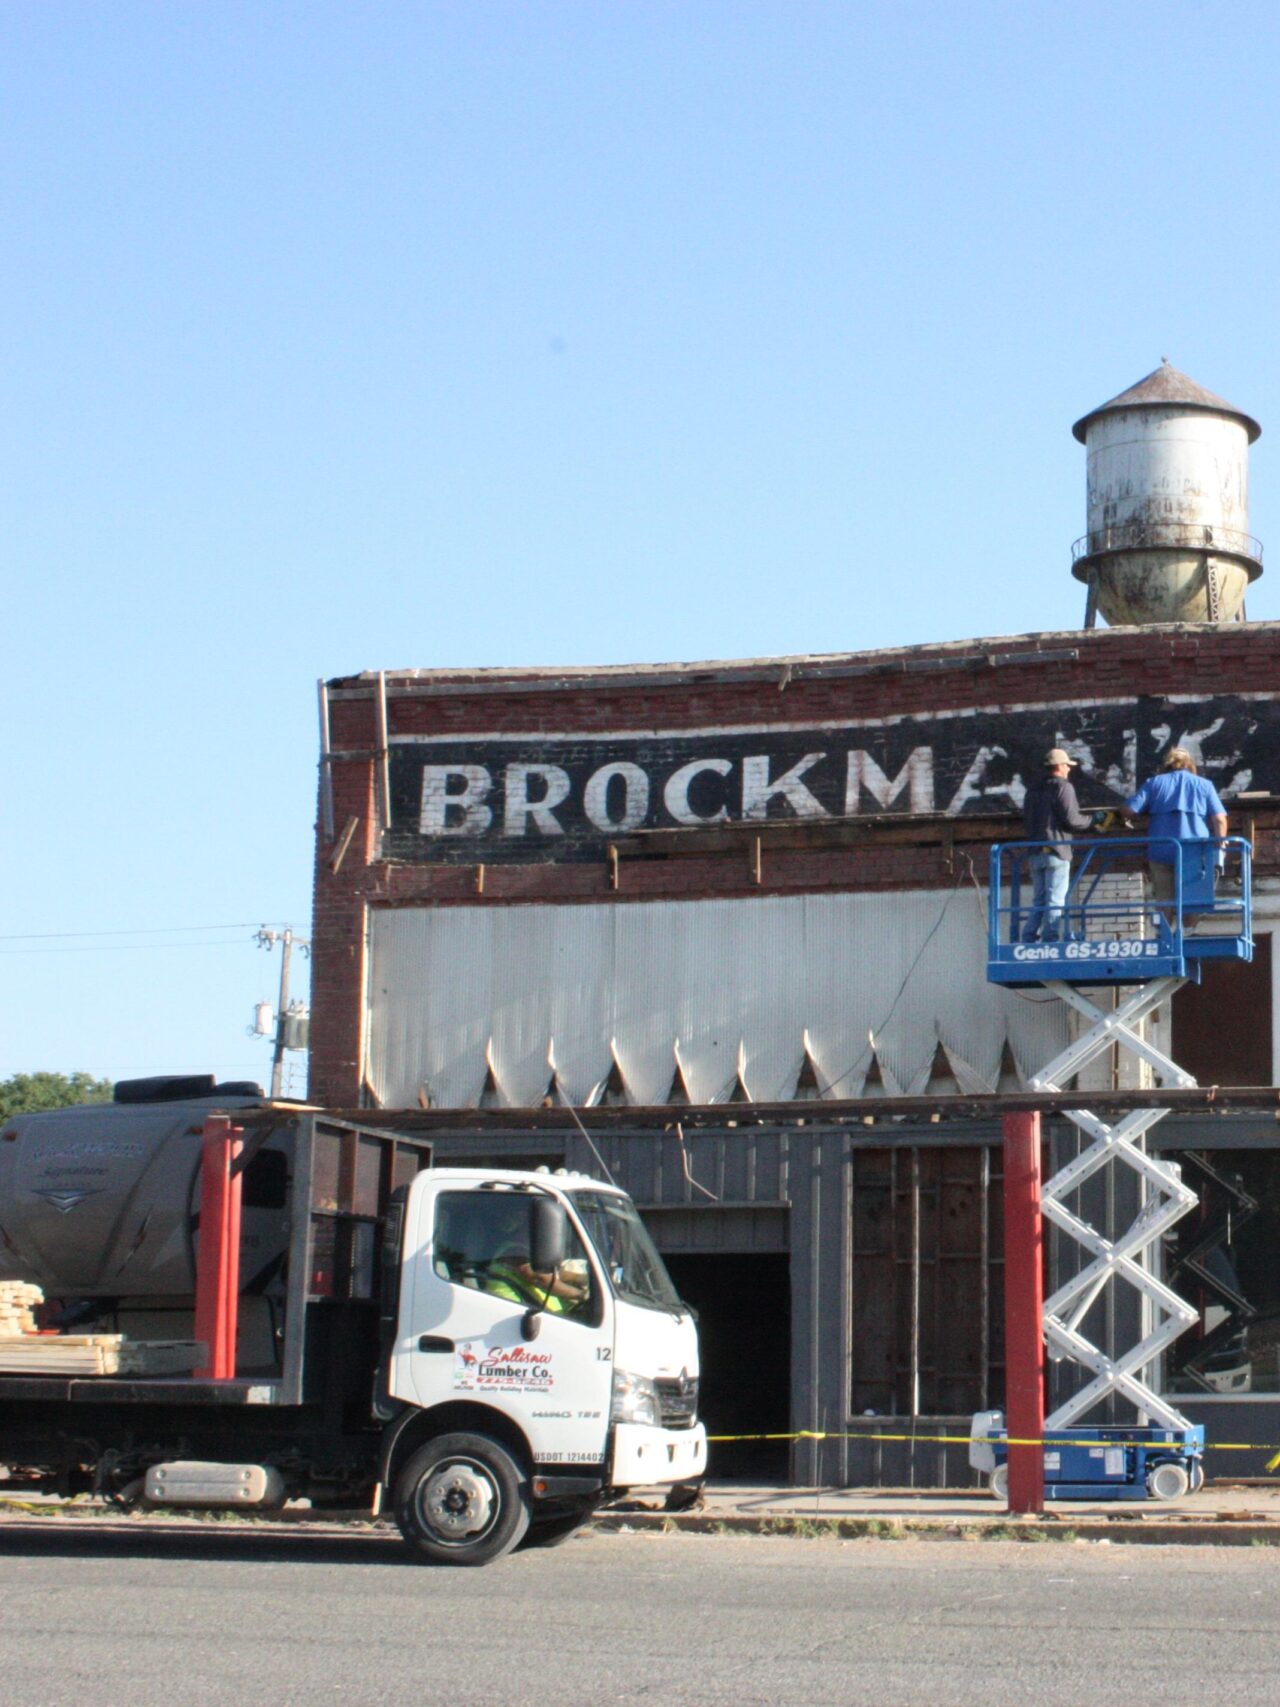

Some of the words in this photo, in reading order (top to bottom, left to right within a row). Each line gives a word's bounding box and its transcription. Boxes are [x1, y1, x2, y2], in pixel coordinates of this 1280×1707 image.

[1013, 945, 1060, 960] Genie
[1065, 941, 1142, 959] GS-1930
[596, 1347, 612, 1361] 12
[478, 1364, 528, 1377] Lumber
[532, 1367, 553, 1378] Co.
[534, 1452, 563, 1462] USDOT
